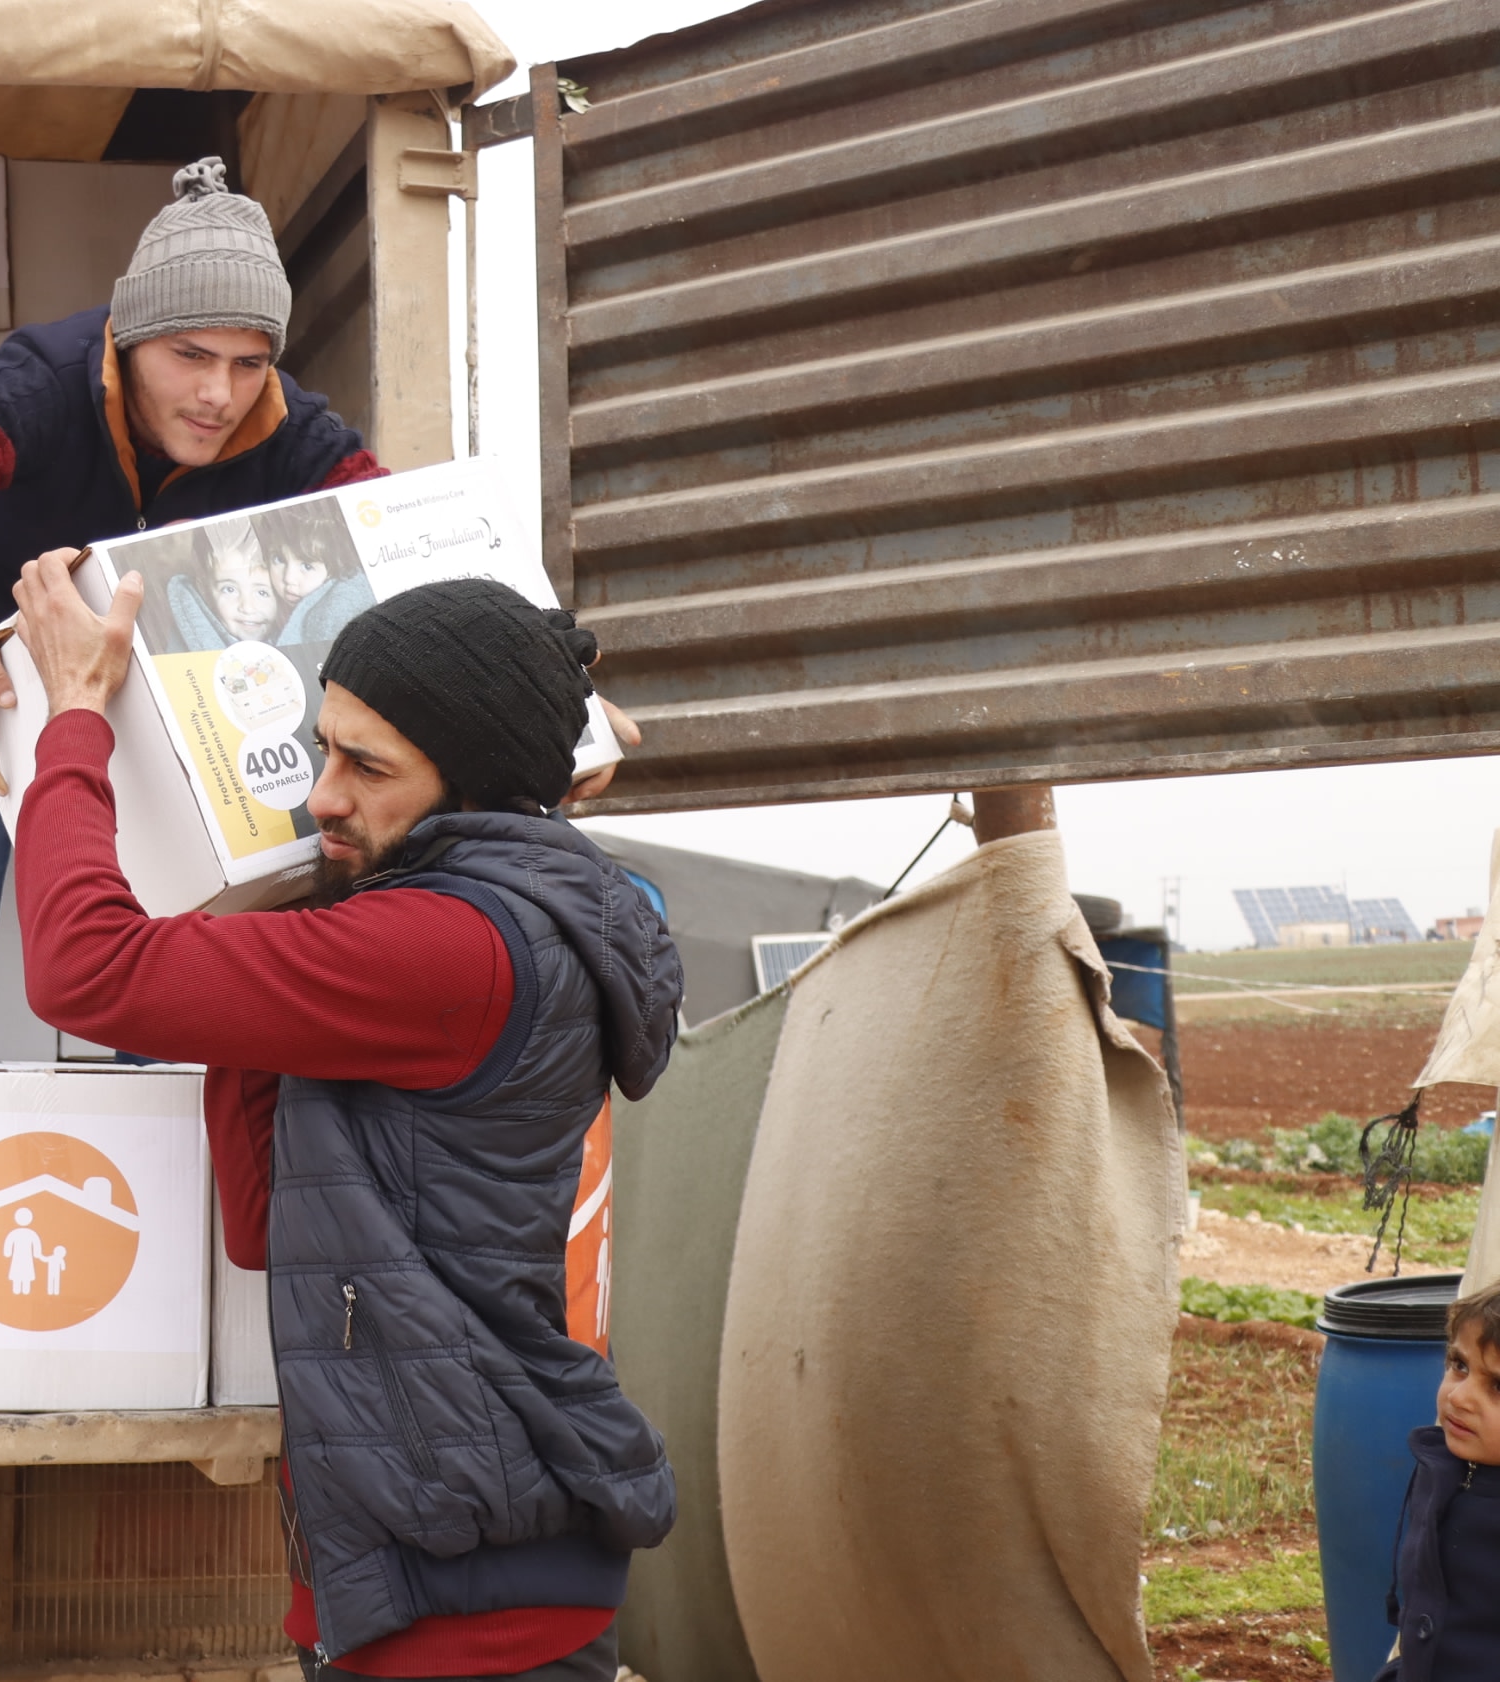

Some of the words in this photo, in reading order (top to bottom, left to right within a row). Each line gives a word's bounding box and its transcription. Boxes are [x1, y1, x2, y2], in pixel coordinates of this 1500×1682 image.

[386, 500, 417, 514] Orphans
[417, 498, 423, 507] &
[449, 489, 465, 499] Care
[368, 542, 417, 567] Alalusi
[418, 528, 485, 558] Foundation
[186, 669, 206, 709] flourish
[190, 709, 208, 746] family,
[202, 707, 215, 731] will
[205, 746, 216, 766] the
[212, 731, 243, 794] generations
[246, 742, 299, 779] 400
[212, 767, 232, 806] Protect
[251, 781, 275, 795] FOOD
[275, 771, 310, 788] PARCELS
[239, 794, 259, 837] Coming
